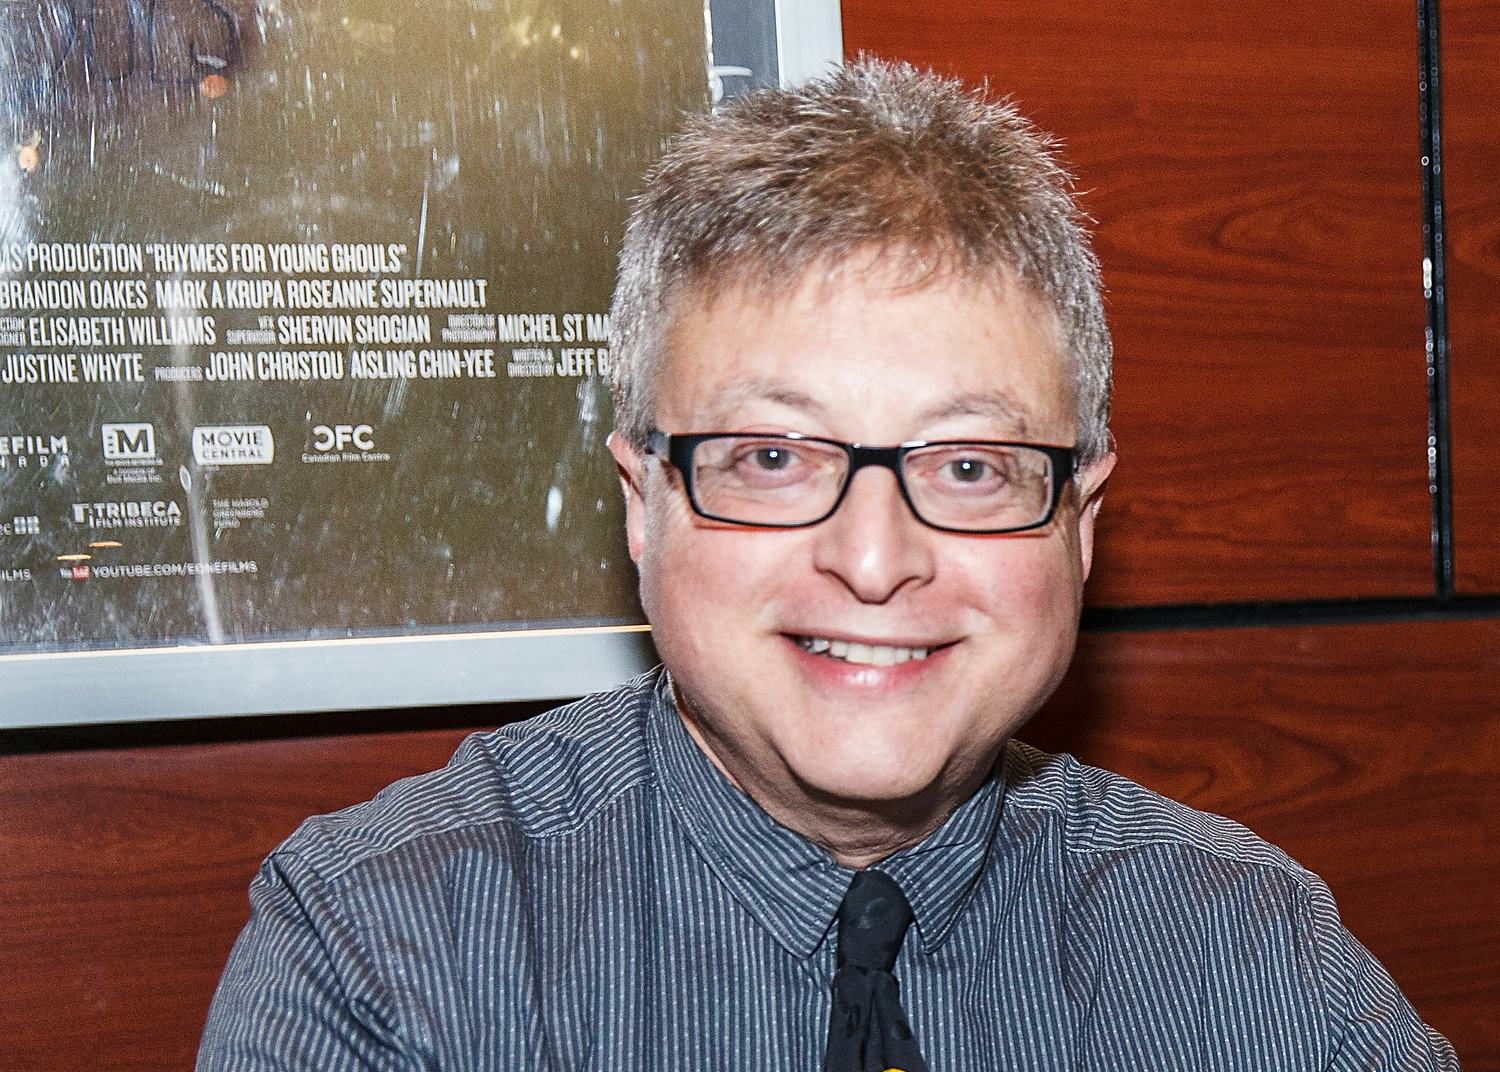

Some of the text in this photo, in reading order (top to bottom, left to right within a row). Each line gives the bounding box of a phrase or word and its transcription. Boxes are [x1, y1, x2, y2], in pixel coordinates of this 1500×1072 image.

[27, 243, 144, 273] PRODUCTION
[231, 243, 267, 273] FOR
[268, 243, 330, 273] YOUNG
[0, 279, 488, 310] BRANDON OAKES MARK A KRUPA ROSEANNE SUPERNAULT
[29, 315, 217, 346] ELISABETH WILLIAMS
[277, 313, 432, 345] SHERVIN SHOGIAN
[498, 313, 562, 343] MICHEL
[562, 313, 586, 342] ST
[1, 352, 146, 384] JUSTINE WHYTE
[205, 348, 497, 382] JOHN CHRISTOU AISLING CHIN-YEE
[556, 347, 596, 378] JEFF
[202, 431, 264, 447] MOVIE
[202, 449, 263, 459] CENTRAL
[94, 500, 182, 519] TRIBECA
[95, 516, 182, 529] FILM INSTITUTE
